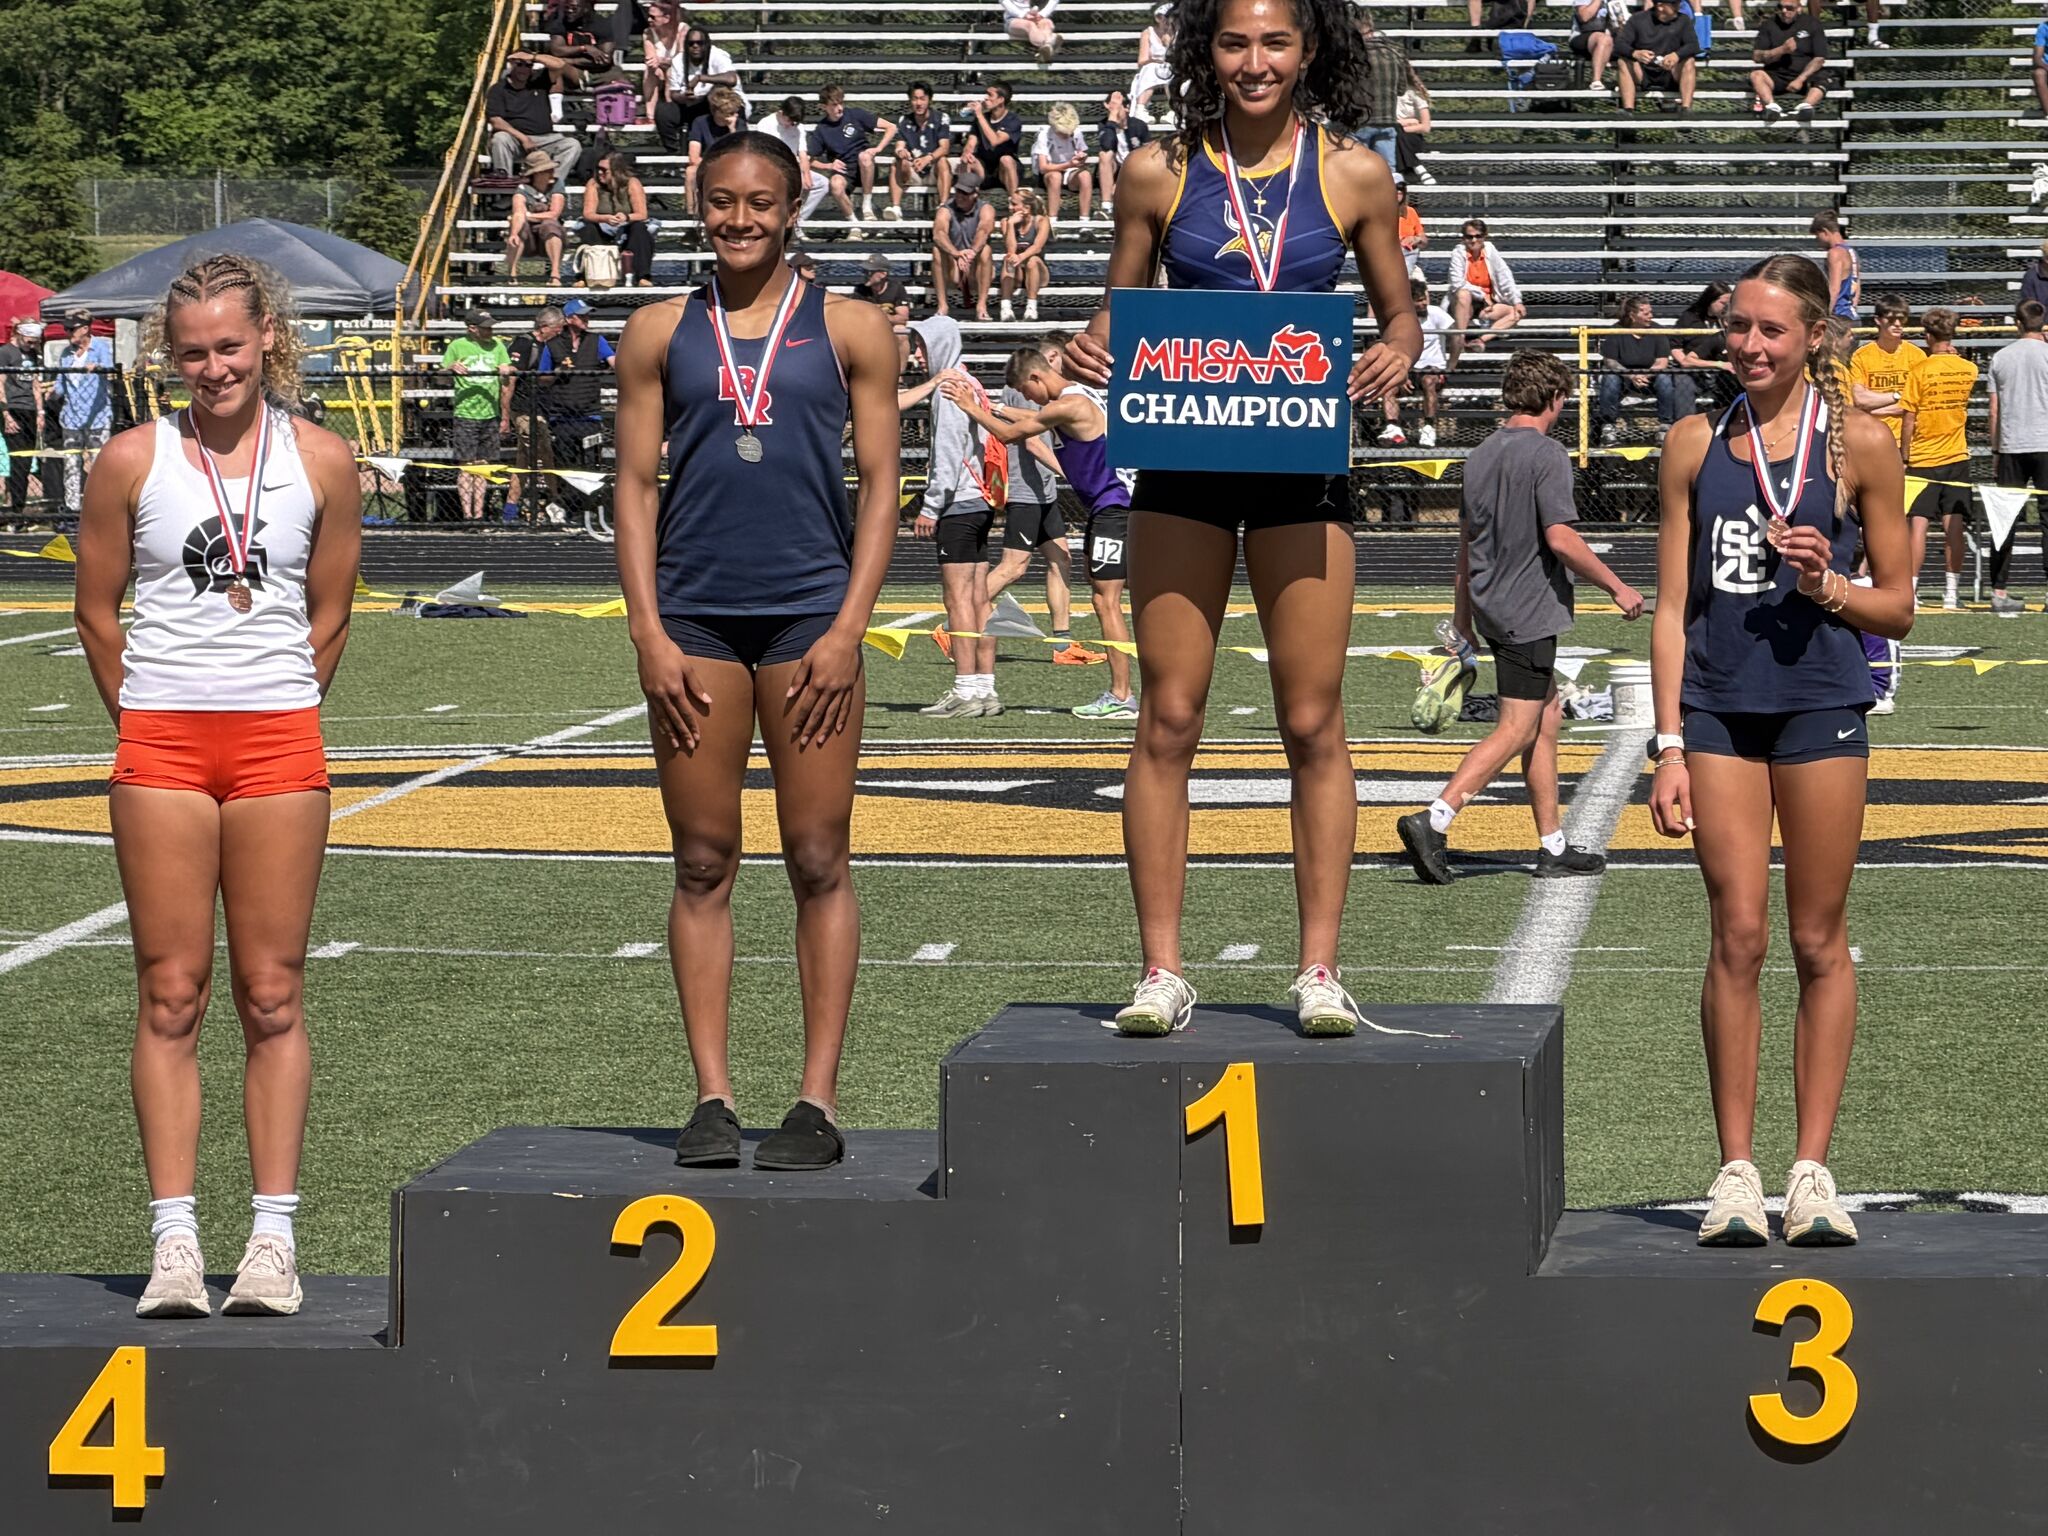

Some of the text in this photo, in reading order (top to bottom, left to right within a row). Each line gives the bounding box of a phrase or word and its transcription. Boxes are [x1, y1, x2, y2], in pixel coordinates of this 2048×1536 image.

[1119, 392, 1339, 428] CHAMPION
[1129, 336, 1303, 385] MHSAA
[1097, 540, 1121, 563] 12
[1185, 1062, 1265, 1226] 1
[609, 1194, 719, 1357] 2
[49, 1346, 165, 1508] 4
[1749, 1278, 1859, 1445] 3
